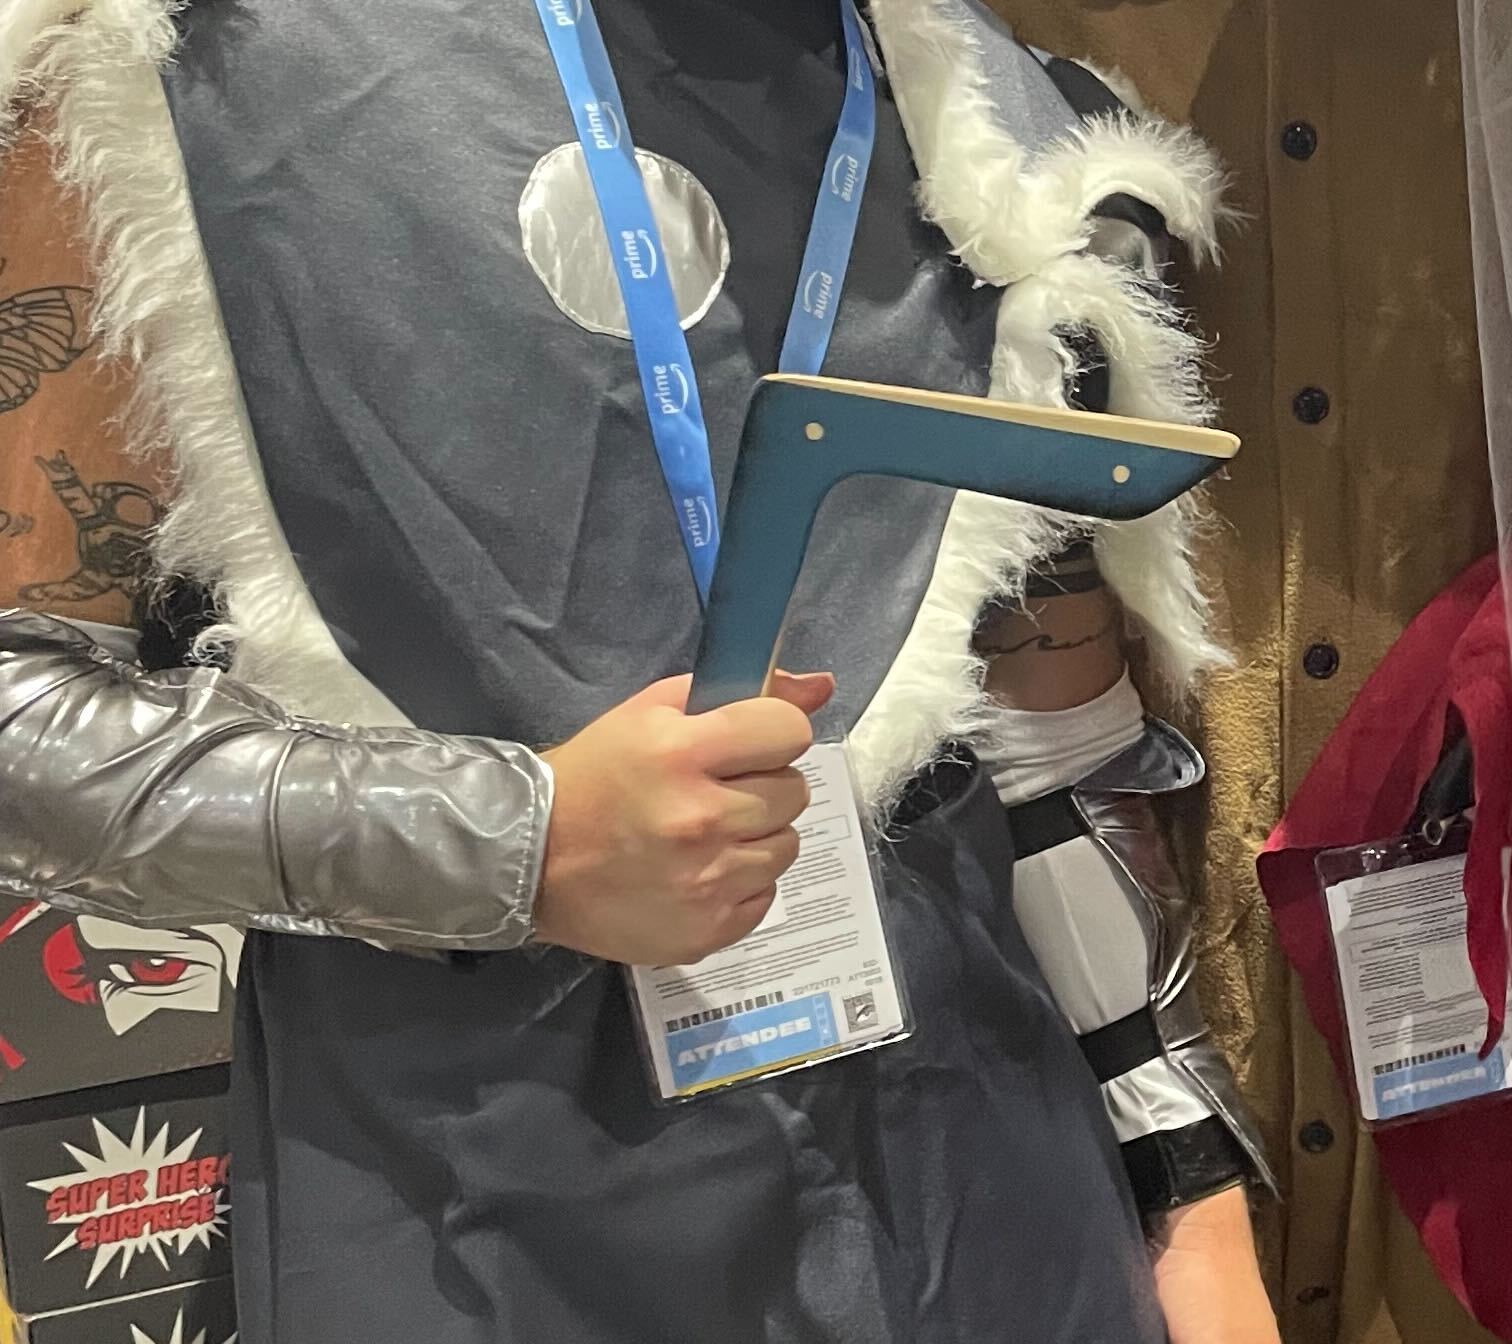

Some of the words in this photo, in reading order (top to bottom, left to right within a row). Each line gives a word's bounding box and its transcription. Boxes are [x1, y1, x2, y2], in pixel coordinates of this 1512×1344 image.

[585, 103, 612, 150] prime
[841, 155, 858, 202] prime
[621, 230, 647, 279] prime
[813, 271, 833, 319] prime
[653, 365, 680, 415] prime
[684, 498, 705, 548] prime
[677, 1016, 812, 1067] ATTENDEE
[46, 1168, 150, 1224] SUPER
[76, 1192, 216, 1250] SURPRISE
